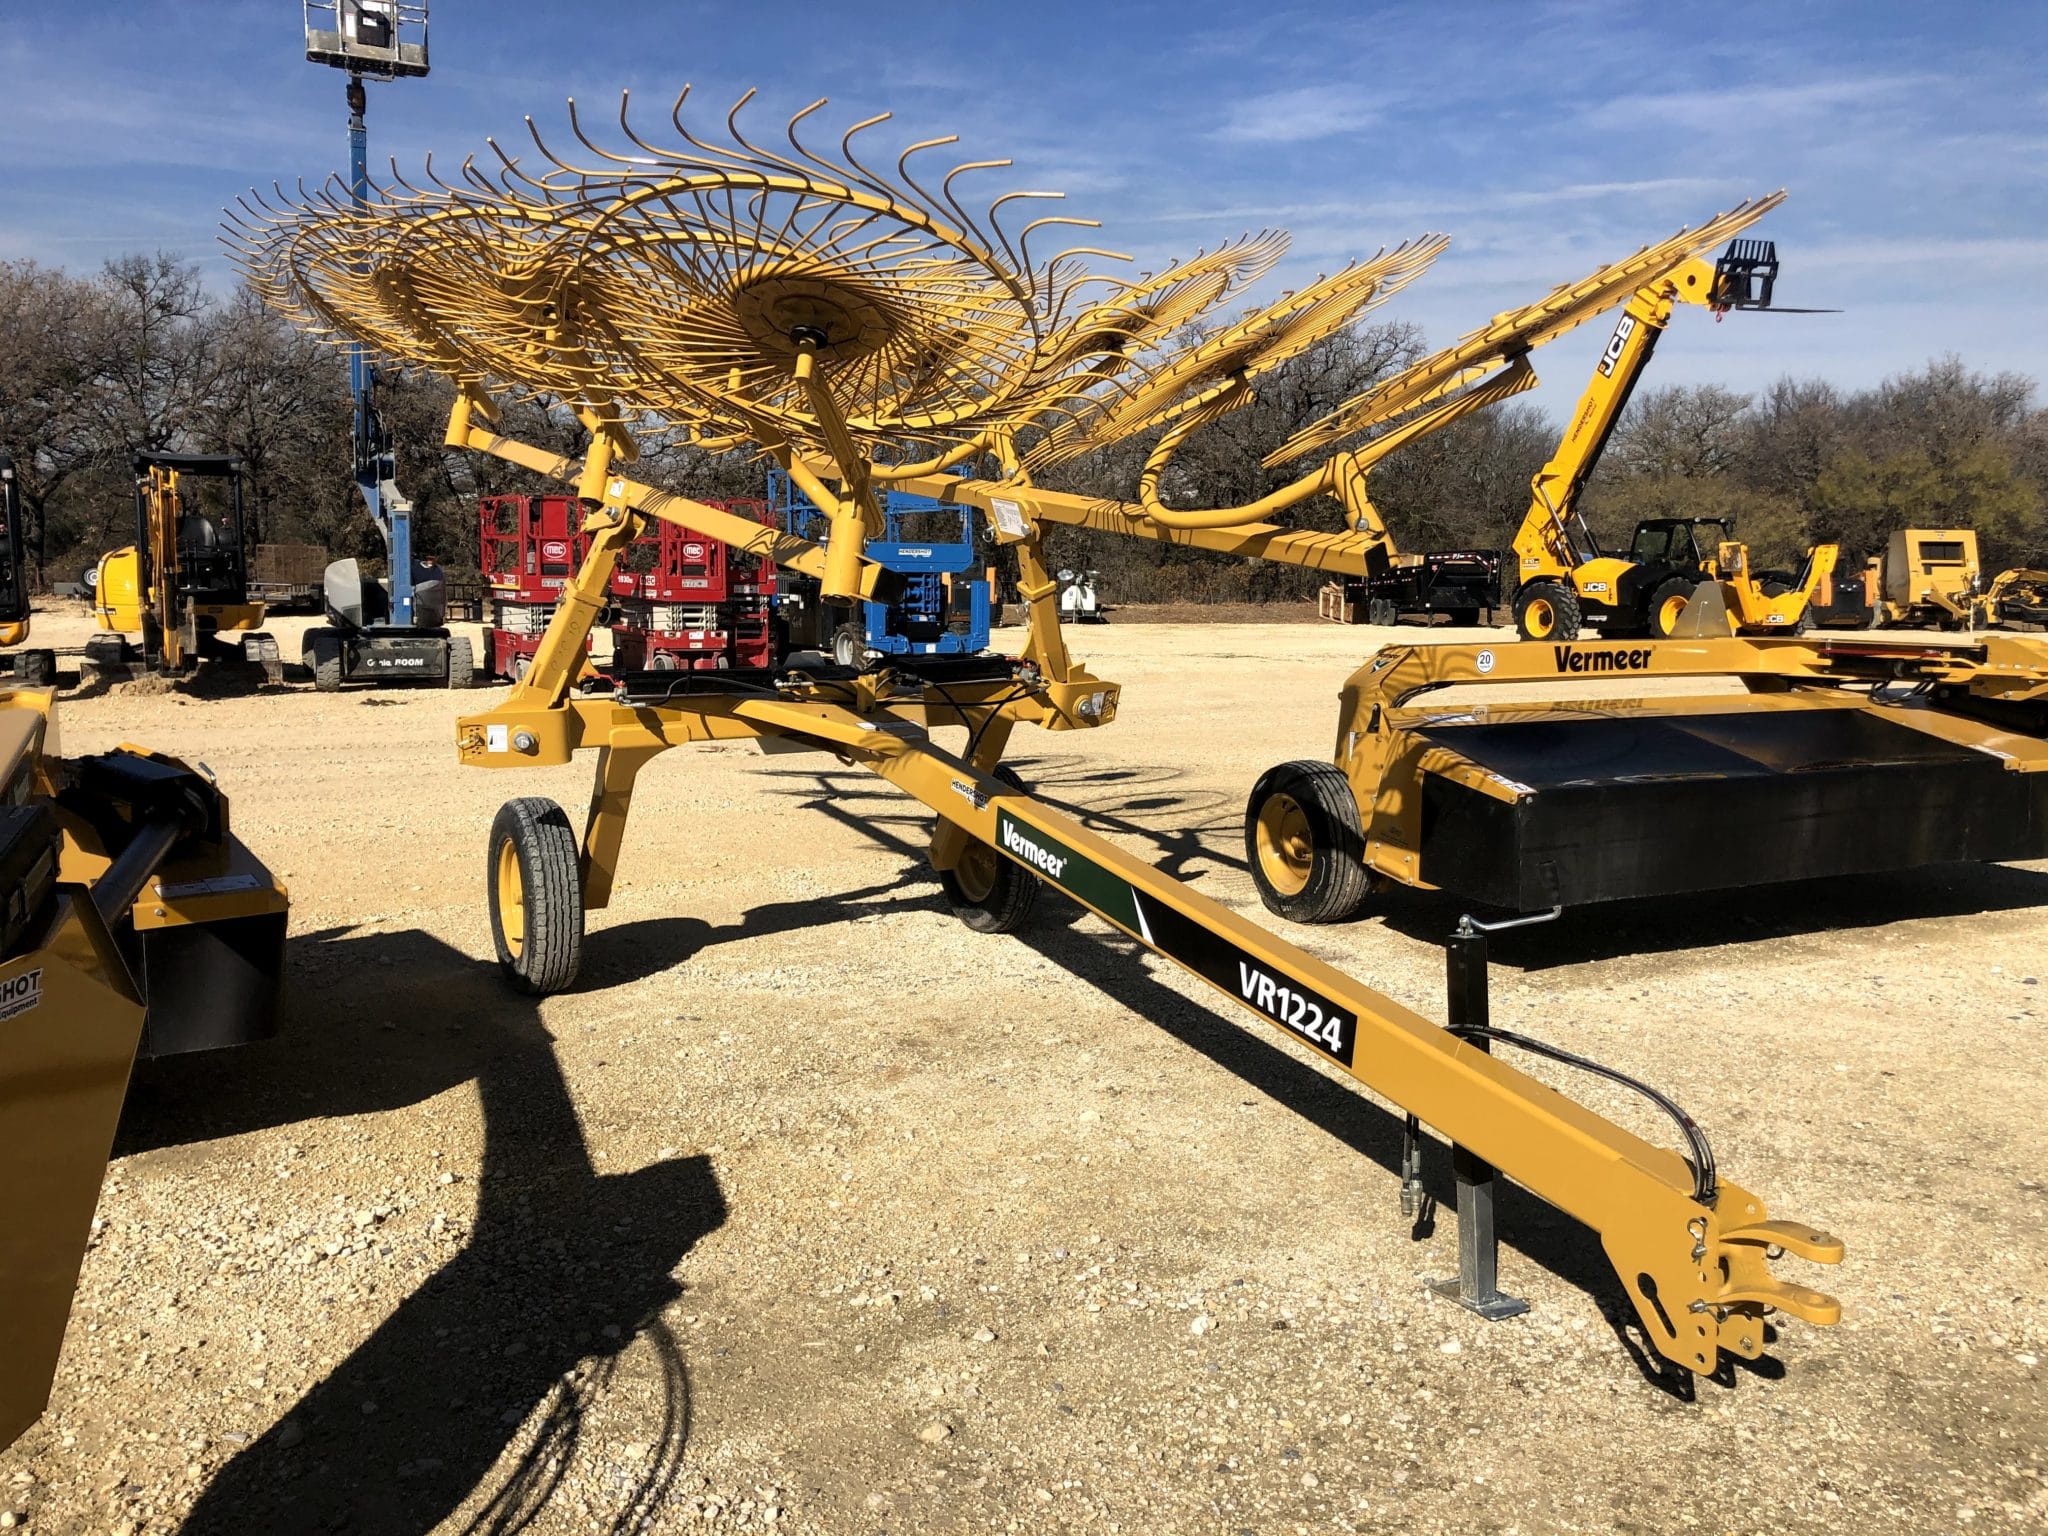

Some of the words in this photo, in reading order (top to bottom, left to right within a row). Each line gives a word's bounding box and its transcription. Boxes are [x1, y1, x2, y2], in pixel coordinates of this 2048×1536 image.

[1603, 315, 1635, 376] JCB
[1583, 583, 1607, 592] JCB
[1480, 655, 1490, 664] 20
[1554, 645, 1652, 673] Vermeer
[951, 780, 988, 802] HENDERSHOT
[1003, 818, 1063, 878] Vermeer
[0, 970, 41, 1003] HOT
[0, 997, 38, 1019] quipment
[1239, 960, 1342, 1053] VR1224
